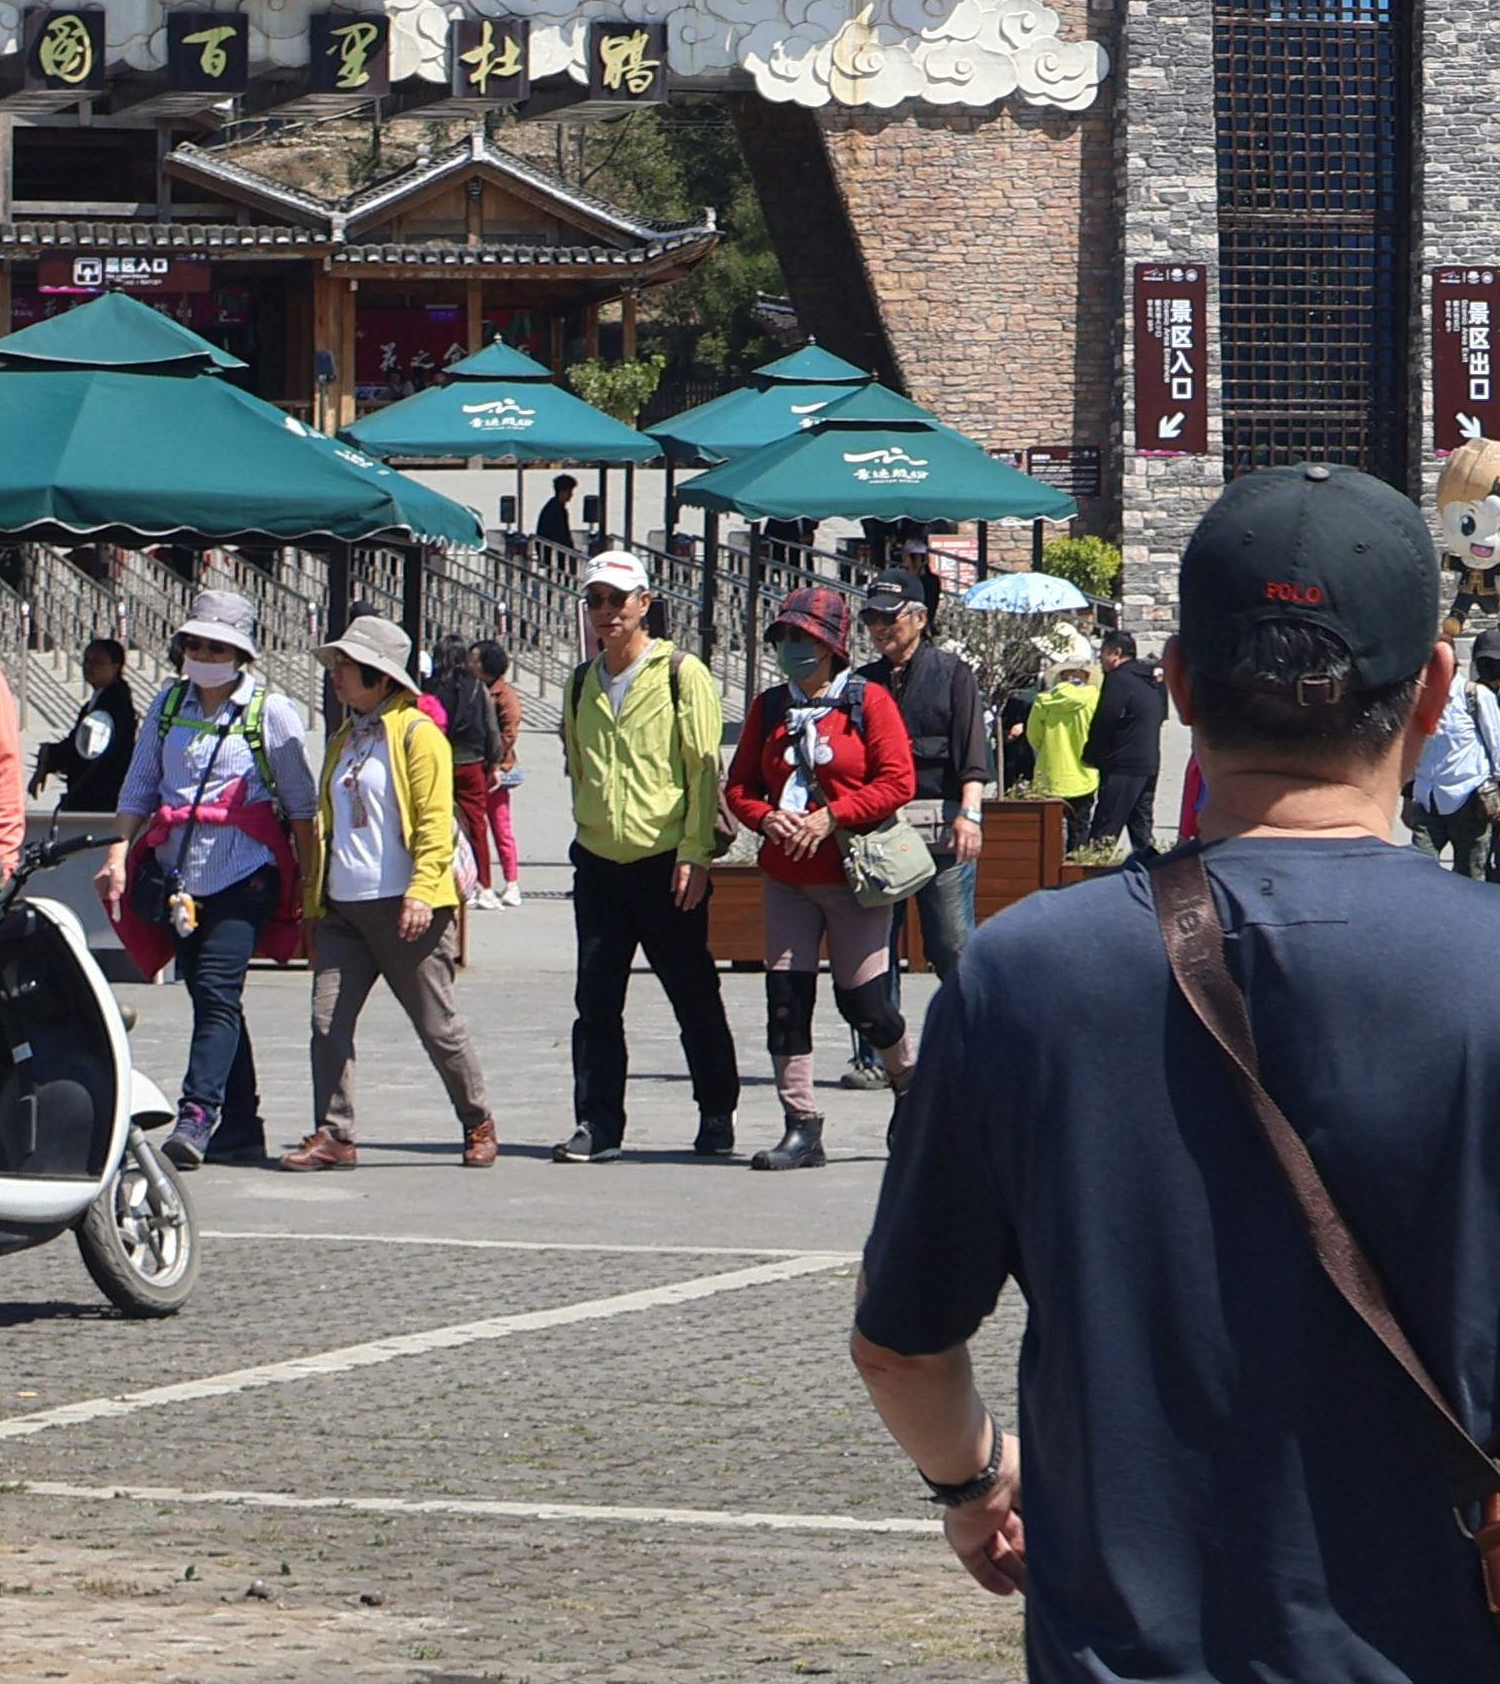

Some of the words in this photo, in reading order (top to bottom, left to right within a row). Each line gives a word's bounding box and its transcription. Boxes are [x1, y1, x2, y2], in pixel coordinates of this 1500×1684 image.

[1170, 299, 1193, 400] 景区入口
[1468, 301, 1490, 400] 景区出口
[1265, 581, 1324, 604] POLO
